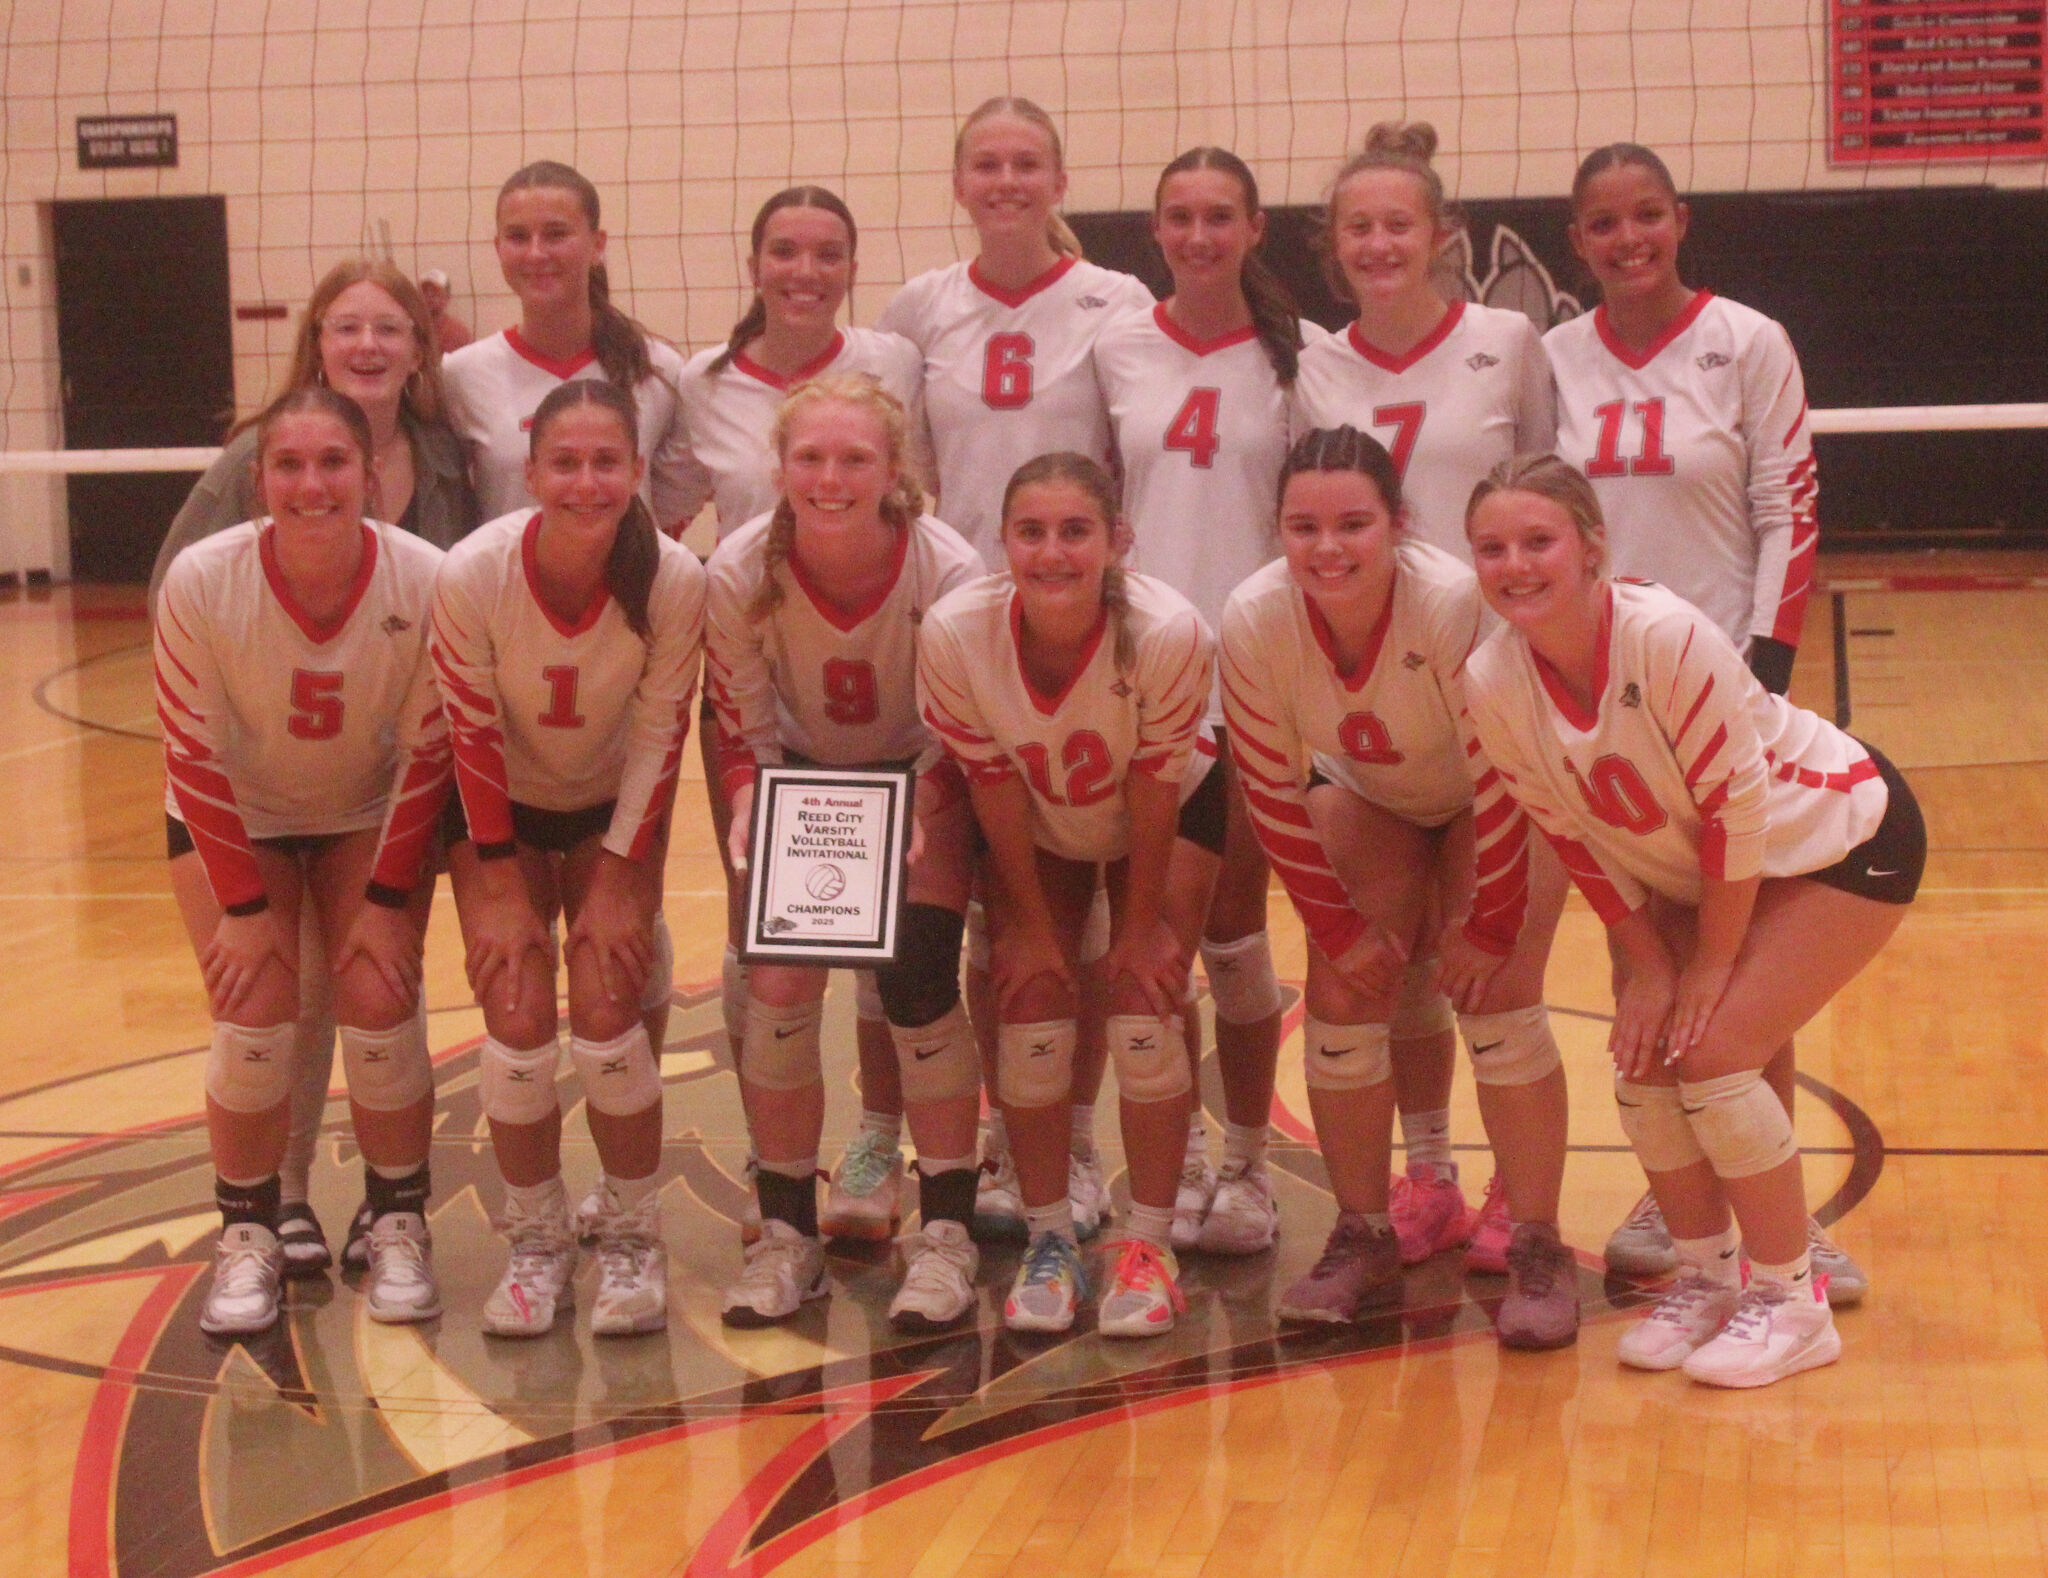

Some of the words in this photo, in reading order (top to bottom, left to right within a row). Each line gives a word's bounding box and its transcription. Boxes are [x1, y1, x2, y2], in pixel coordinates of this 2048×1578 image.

[981, 331, 1034, 410] 6
[1163, 386, 1221, 468] 4
[1373, 400, 1427, 484] 7
[1585, 397, 1675, 477] 11
[287, 668, 344, 740] 5
[538, 666, 585, 729] 1
[822, 659, 880, 725] 9
[1015, 729, 1117, 808] 12
[1563, 752, 1669, 836] 10
[797, 810, 832, 823] REED
[835, 812, 865, 824] CITY
[801, 797, 821, 807] 4th
[825, 798, 864, 808] Annual
[804, 824, 858, 836] VARSITY
[787, 847, 869, 861] INVITATIONAL
[791, 835, 868, 848] VOLLEYBALL
[787, 904, 861, 915] CHAMPIONS
[811, 918, 835, 926] 2025
